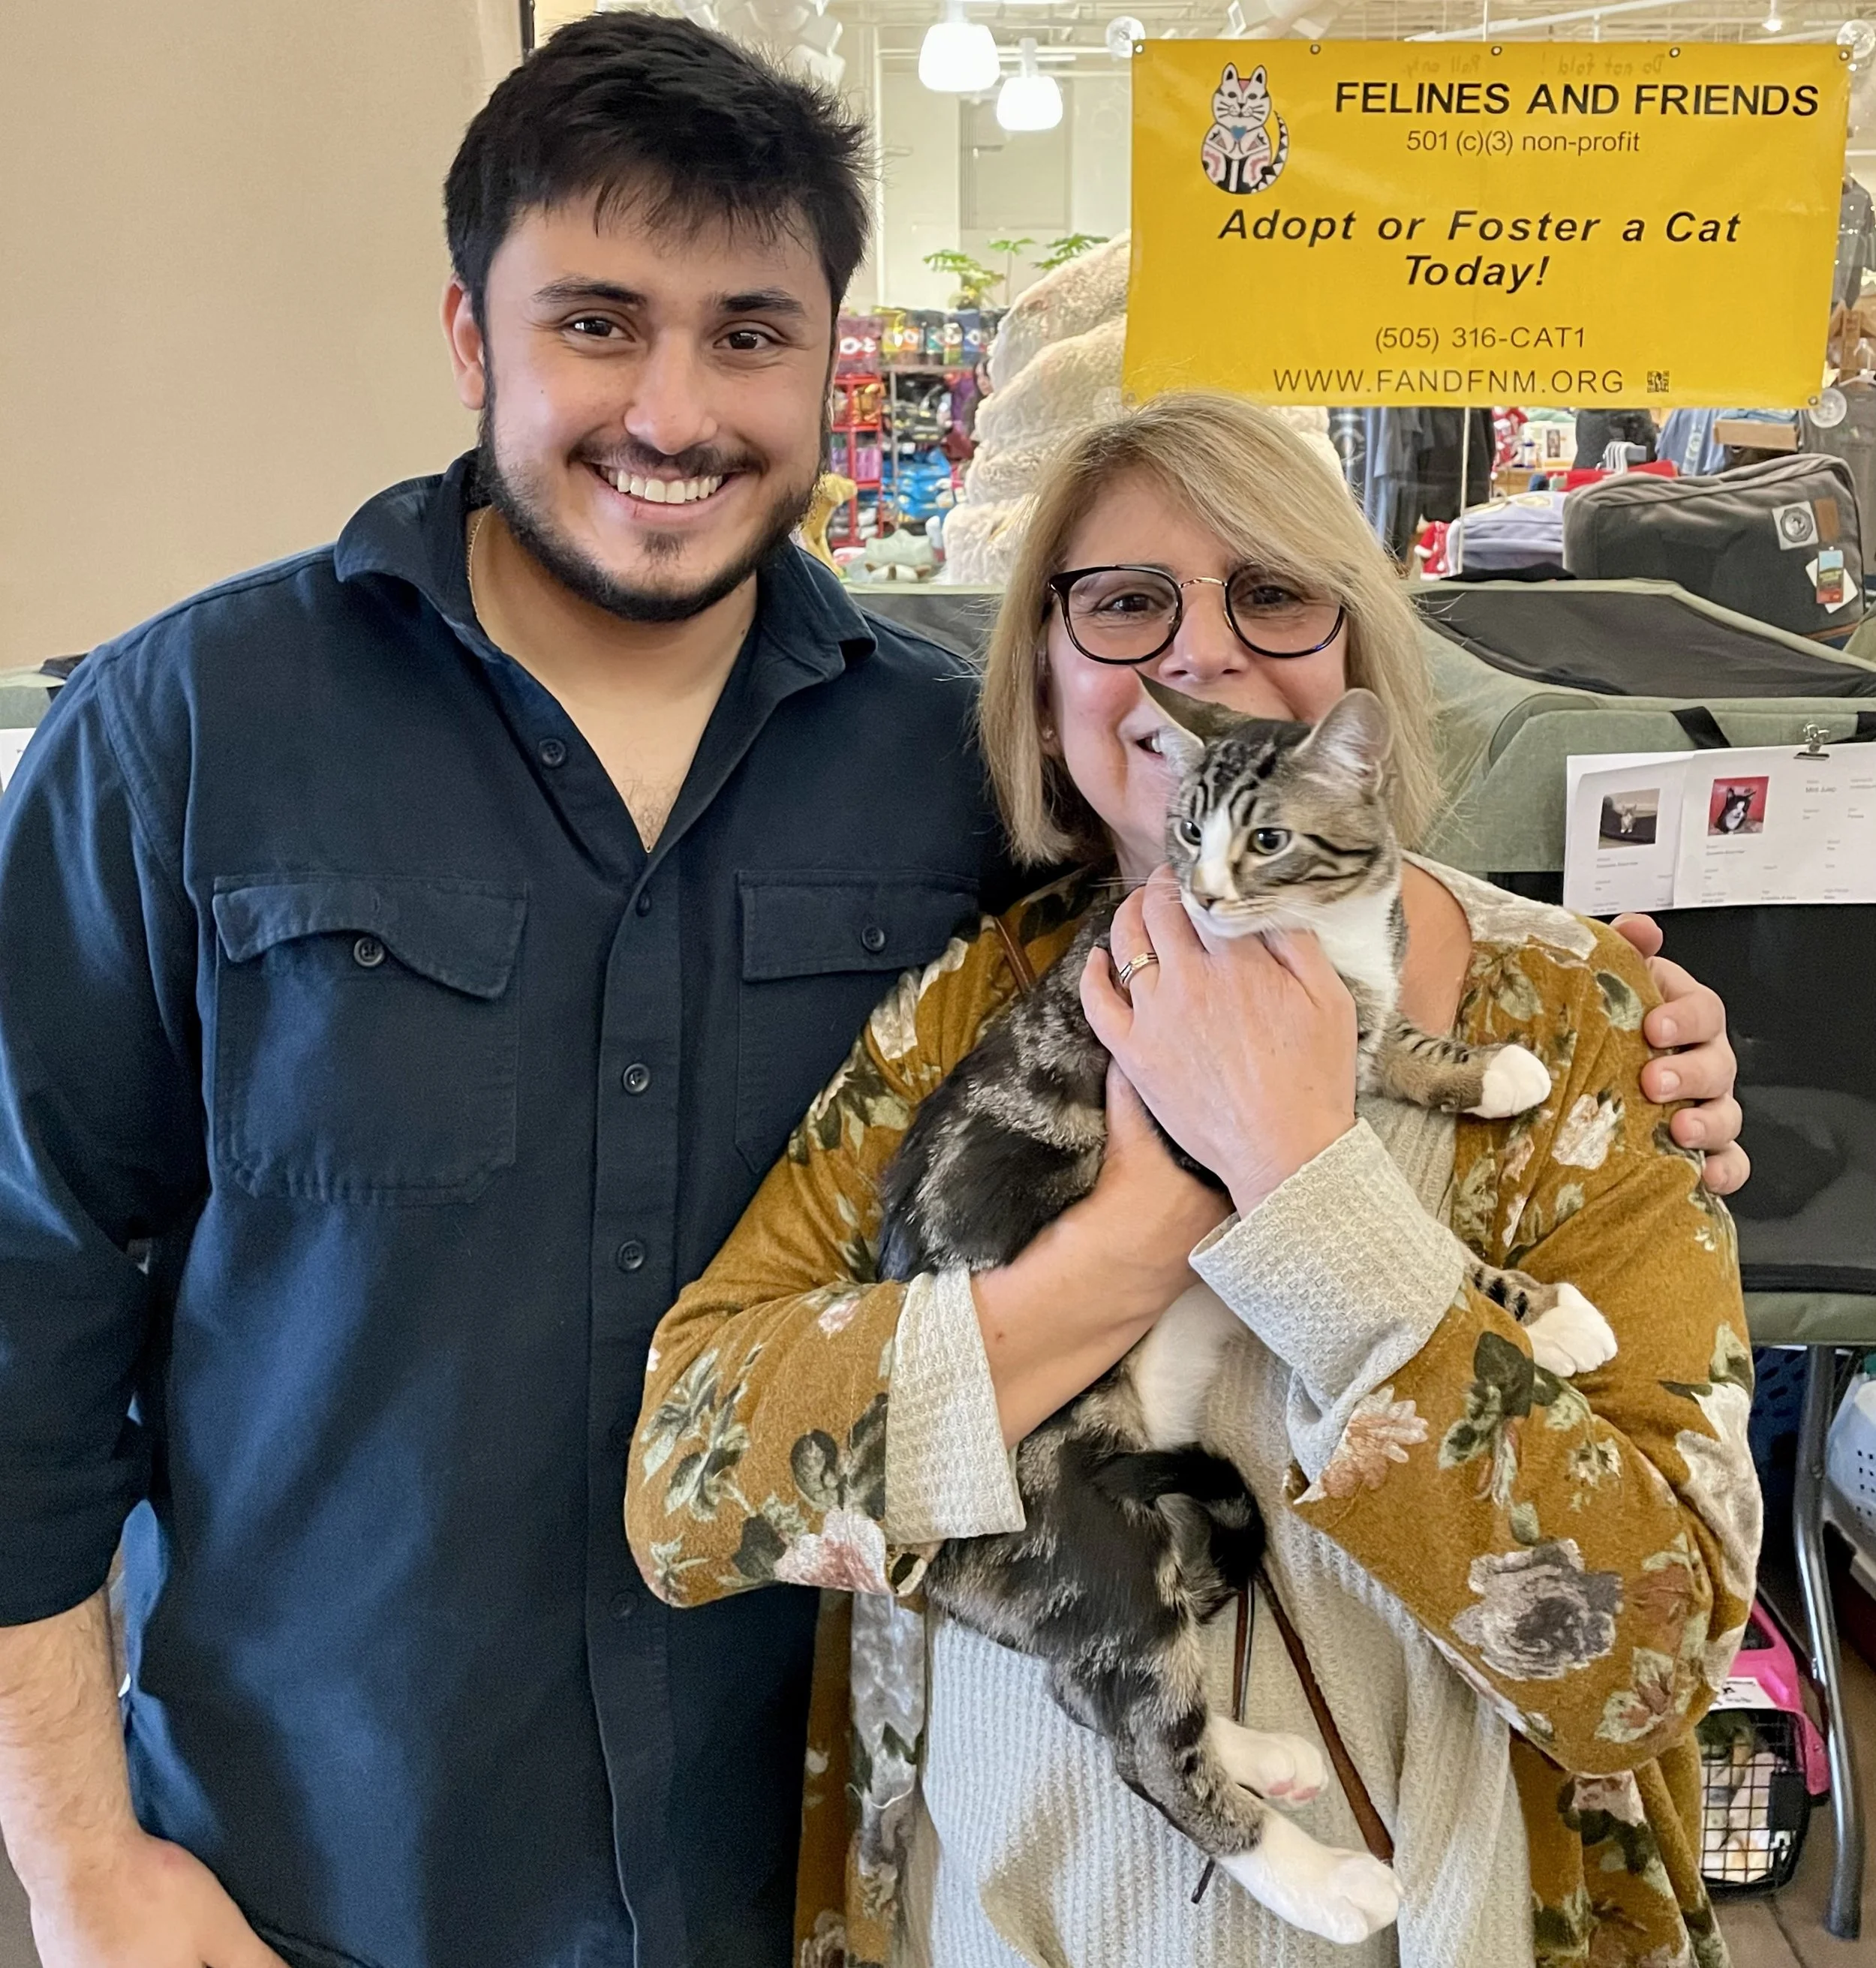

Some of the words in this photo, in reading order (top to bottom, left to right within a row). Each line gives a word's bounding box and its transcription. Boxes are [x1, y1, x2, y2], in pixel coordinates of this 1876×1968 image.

[1336, 82, 1510, 114] FELINES
[1526, 83, 1619, 115] AND
[1634, 84, 1819, 116] FRIENDS
[1407, 130, 1448, 152] 501
[1456, 130, 1514, 156] (c)(3)
[1523, 131, 1640, 158] non-profit
[1217, 209, 1356, 248] Adopt
[1378, 218, 1425, 240] or
[1448, 210, 1601, 242] Foster
[1622, 219, 1645, 242] a
[1666, 212, 1742, 242] Cat
[1405, 255, 1550, 294] Today!
[1375, 327, 1439, 353] (505)
[1452, 326, 1586, 349] 316-CAT1
[1273, 368, 1623, 394] WWW.FANDFNM.ORG
